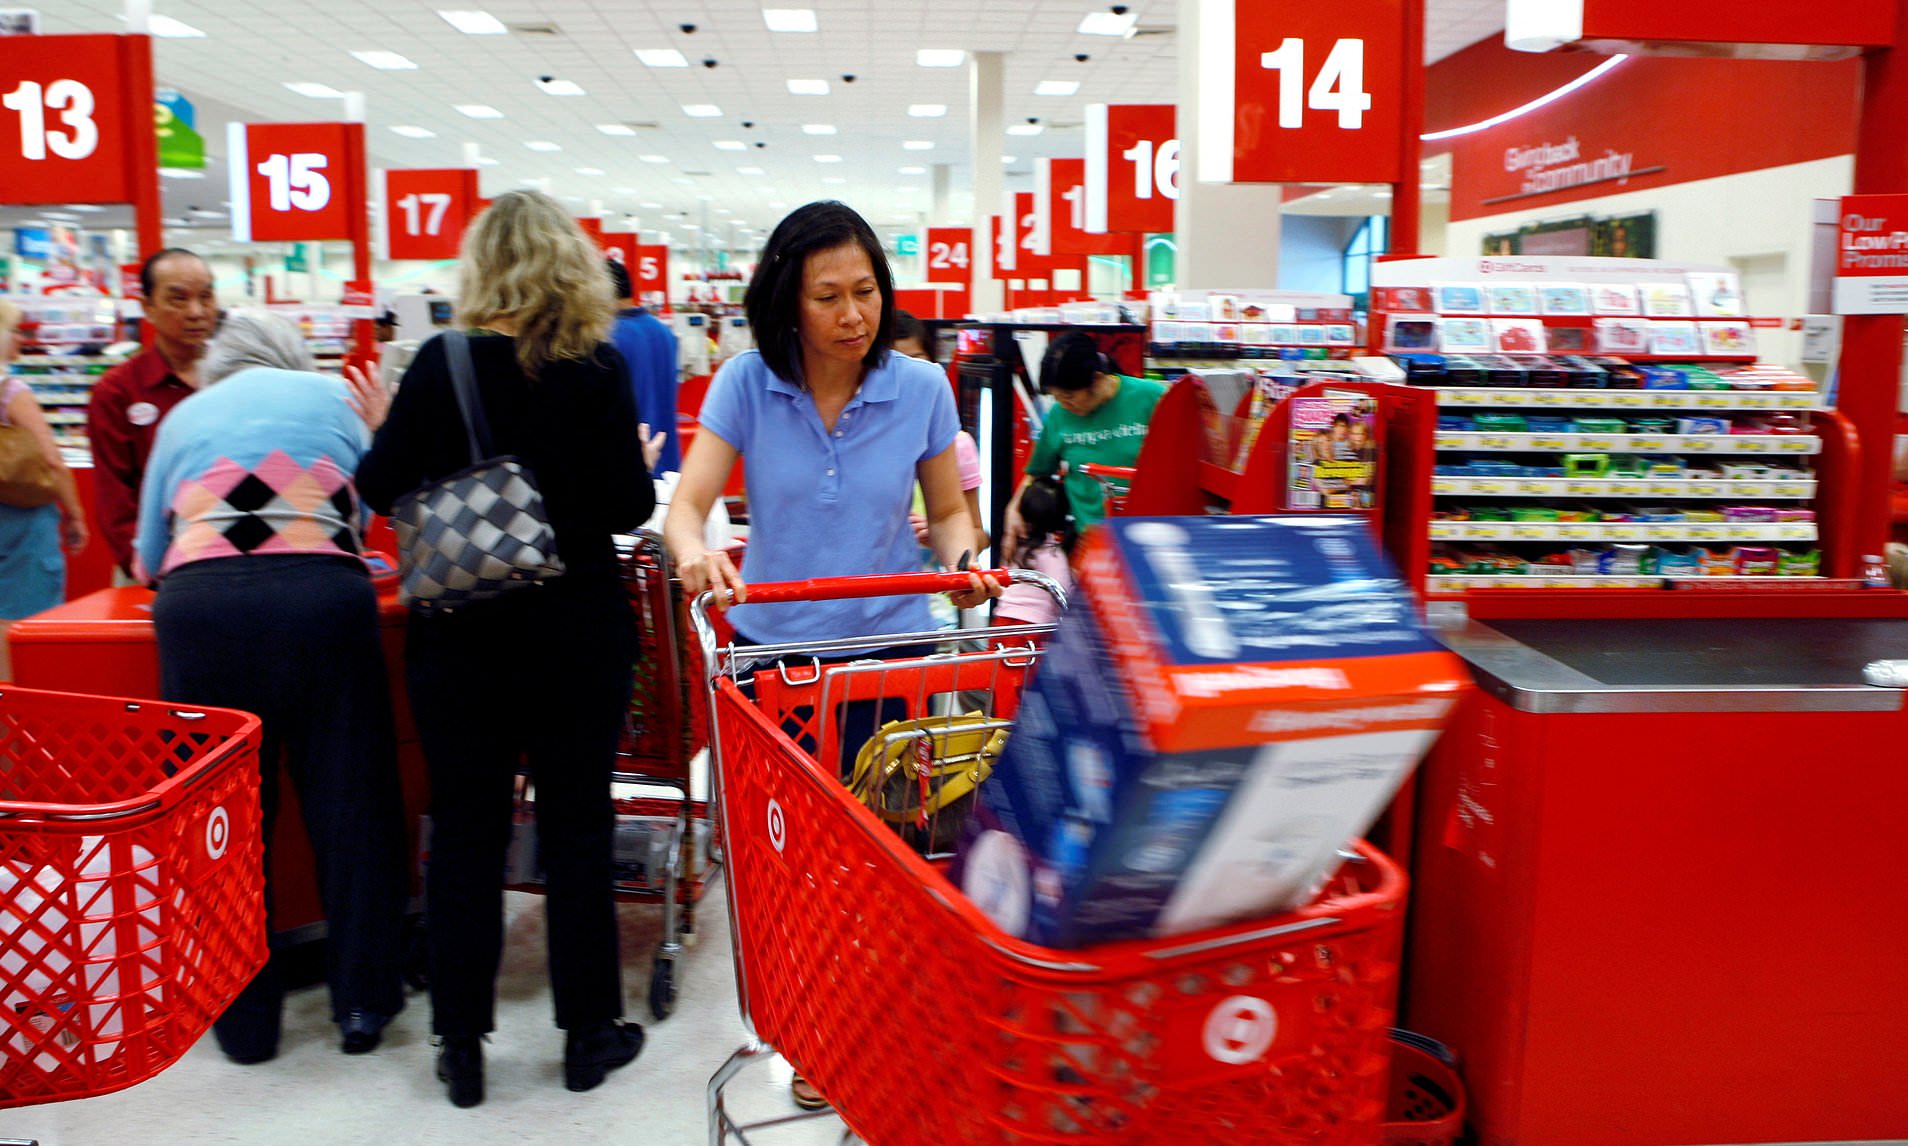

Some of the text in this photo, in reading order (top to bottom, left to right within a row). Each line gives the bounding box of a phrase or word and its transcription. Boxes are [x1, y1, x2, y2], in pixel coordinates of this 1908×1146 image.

[1261, 37, 1371, 129] 14
[2, 79, 98, 160] 13
[257, 153, 330, 211] 15
[1123, 139, 1179, 200] 16
[397, 193, 451, 236] 17
[1842, 213, 1887, 232] Our
[930, 242, 969, 268] 24
[1842, 232, 1890, 250] Low
